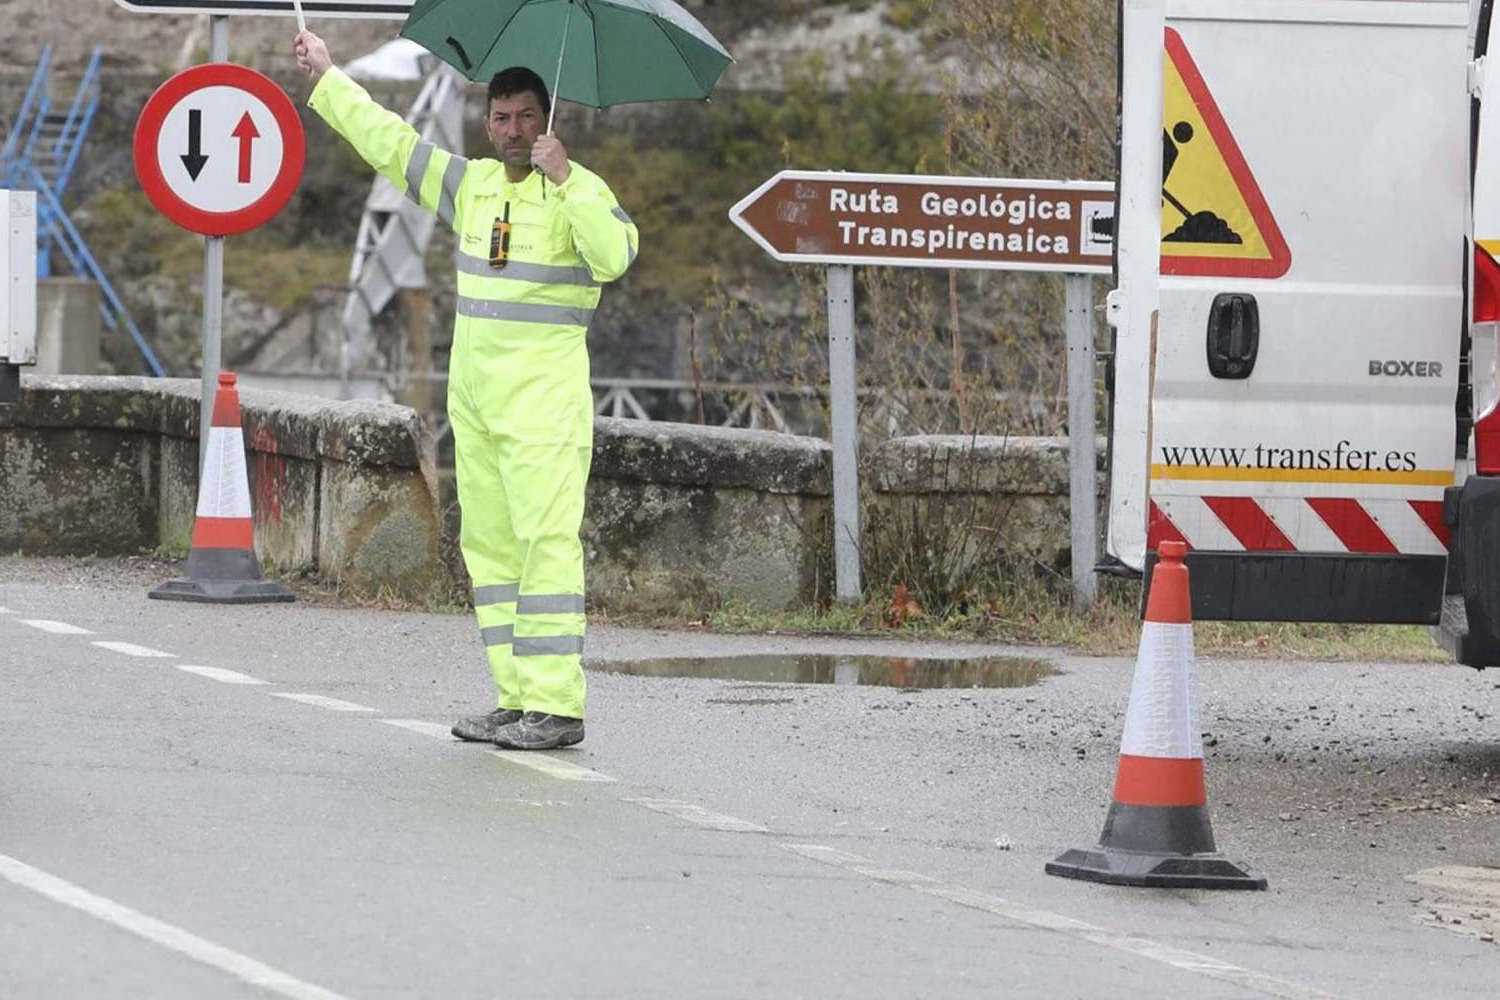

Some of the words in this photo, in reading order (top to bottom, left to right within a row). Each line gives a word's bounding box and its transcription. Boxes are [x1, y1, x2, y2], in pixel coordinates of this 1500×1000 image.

[830, 188, 899, 214] Ruta
[920, 192, 1072, 226] Geológica
[838, 221, 1070, 254] Transpirenaica
[1369, 360, 1443, 378] BOXER
[1161, 440, 1417, 473] www.transfer.es
